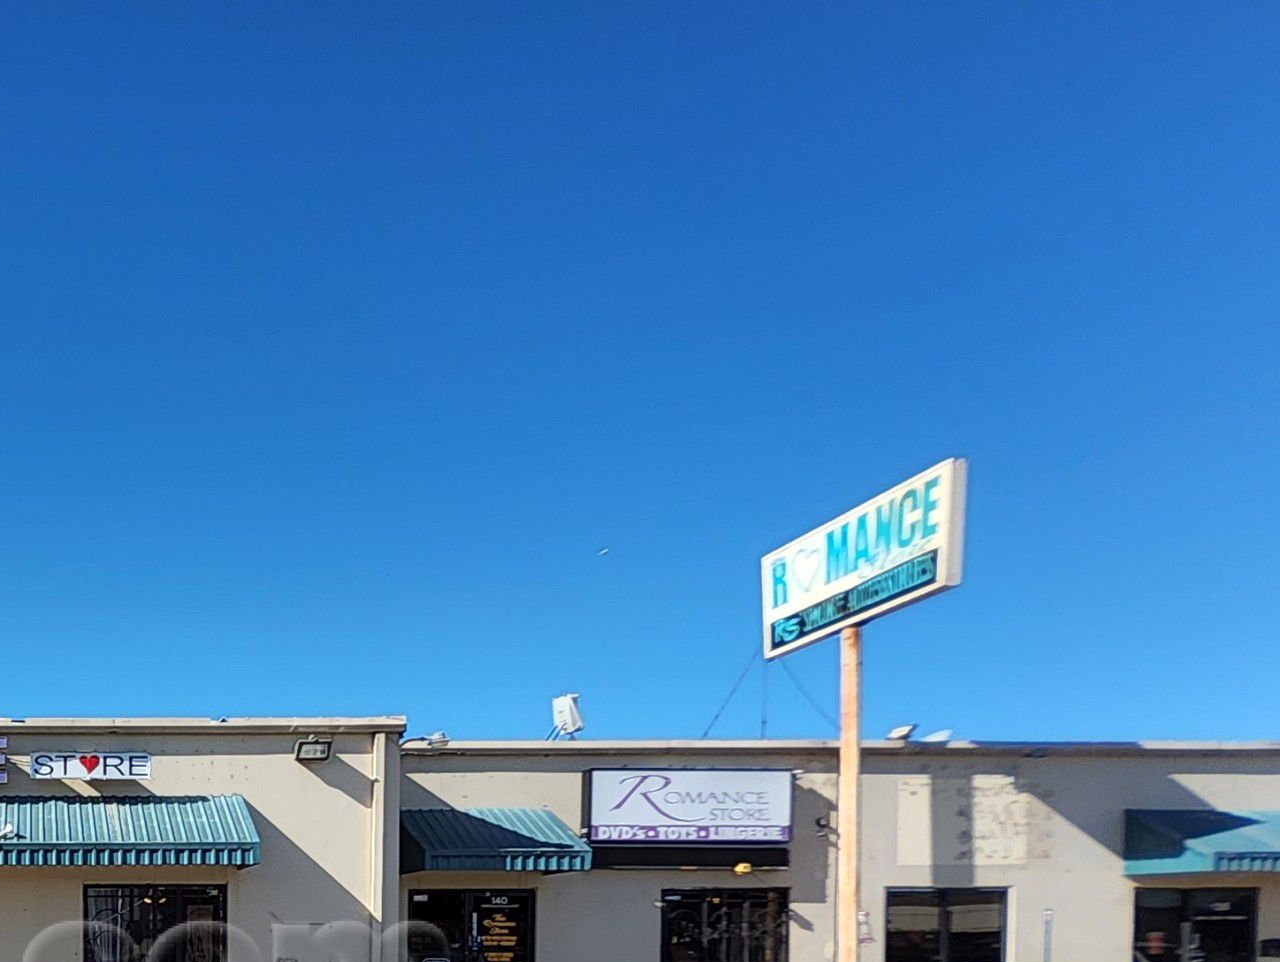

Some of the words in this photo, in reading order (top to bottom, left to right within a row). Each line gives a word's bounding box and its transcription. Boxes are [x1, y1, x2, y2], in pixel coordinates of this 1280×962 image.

[609, 774, 771, 822] ROMANCE
[707, 808, 771, 821] STORE
[708, 826, 785, 841] LINGERIE
[491, 896, 508, 905] 140
